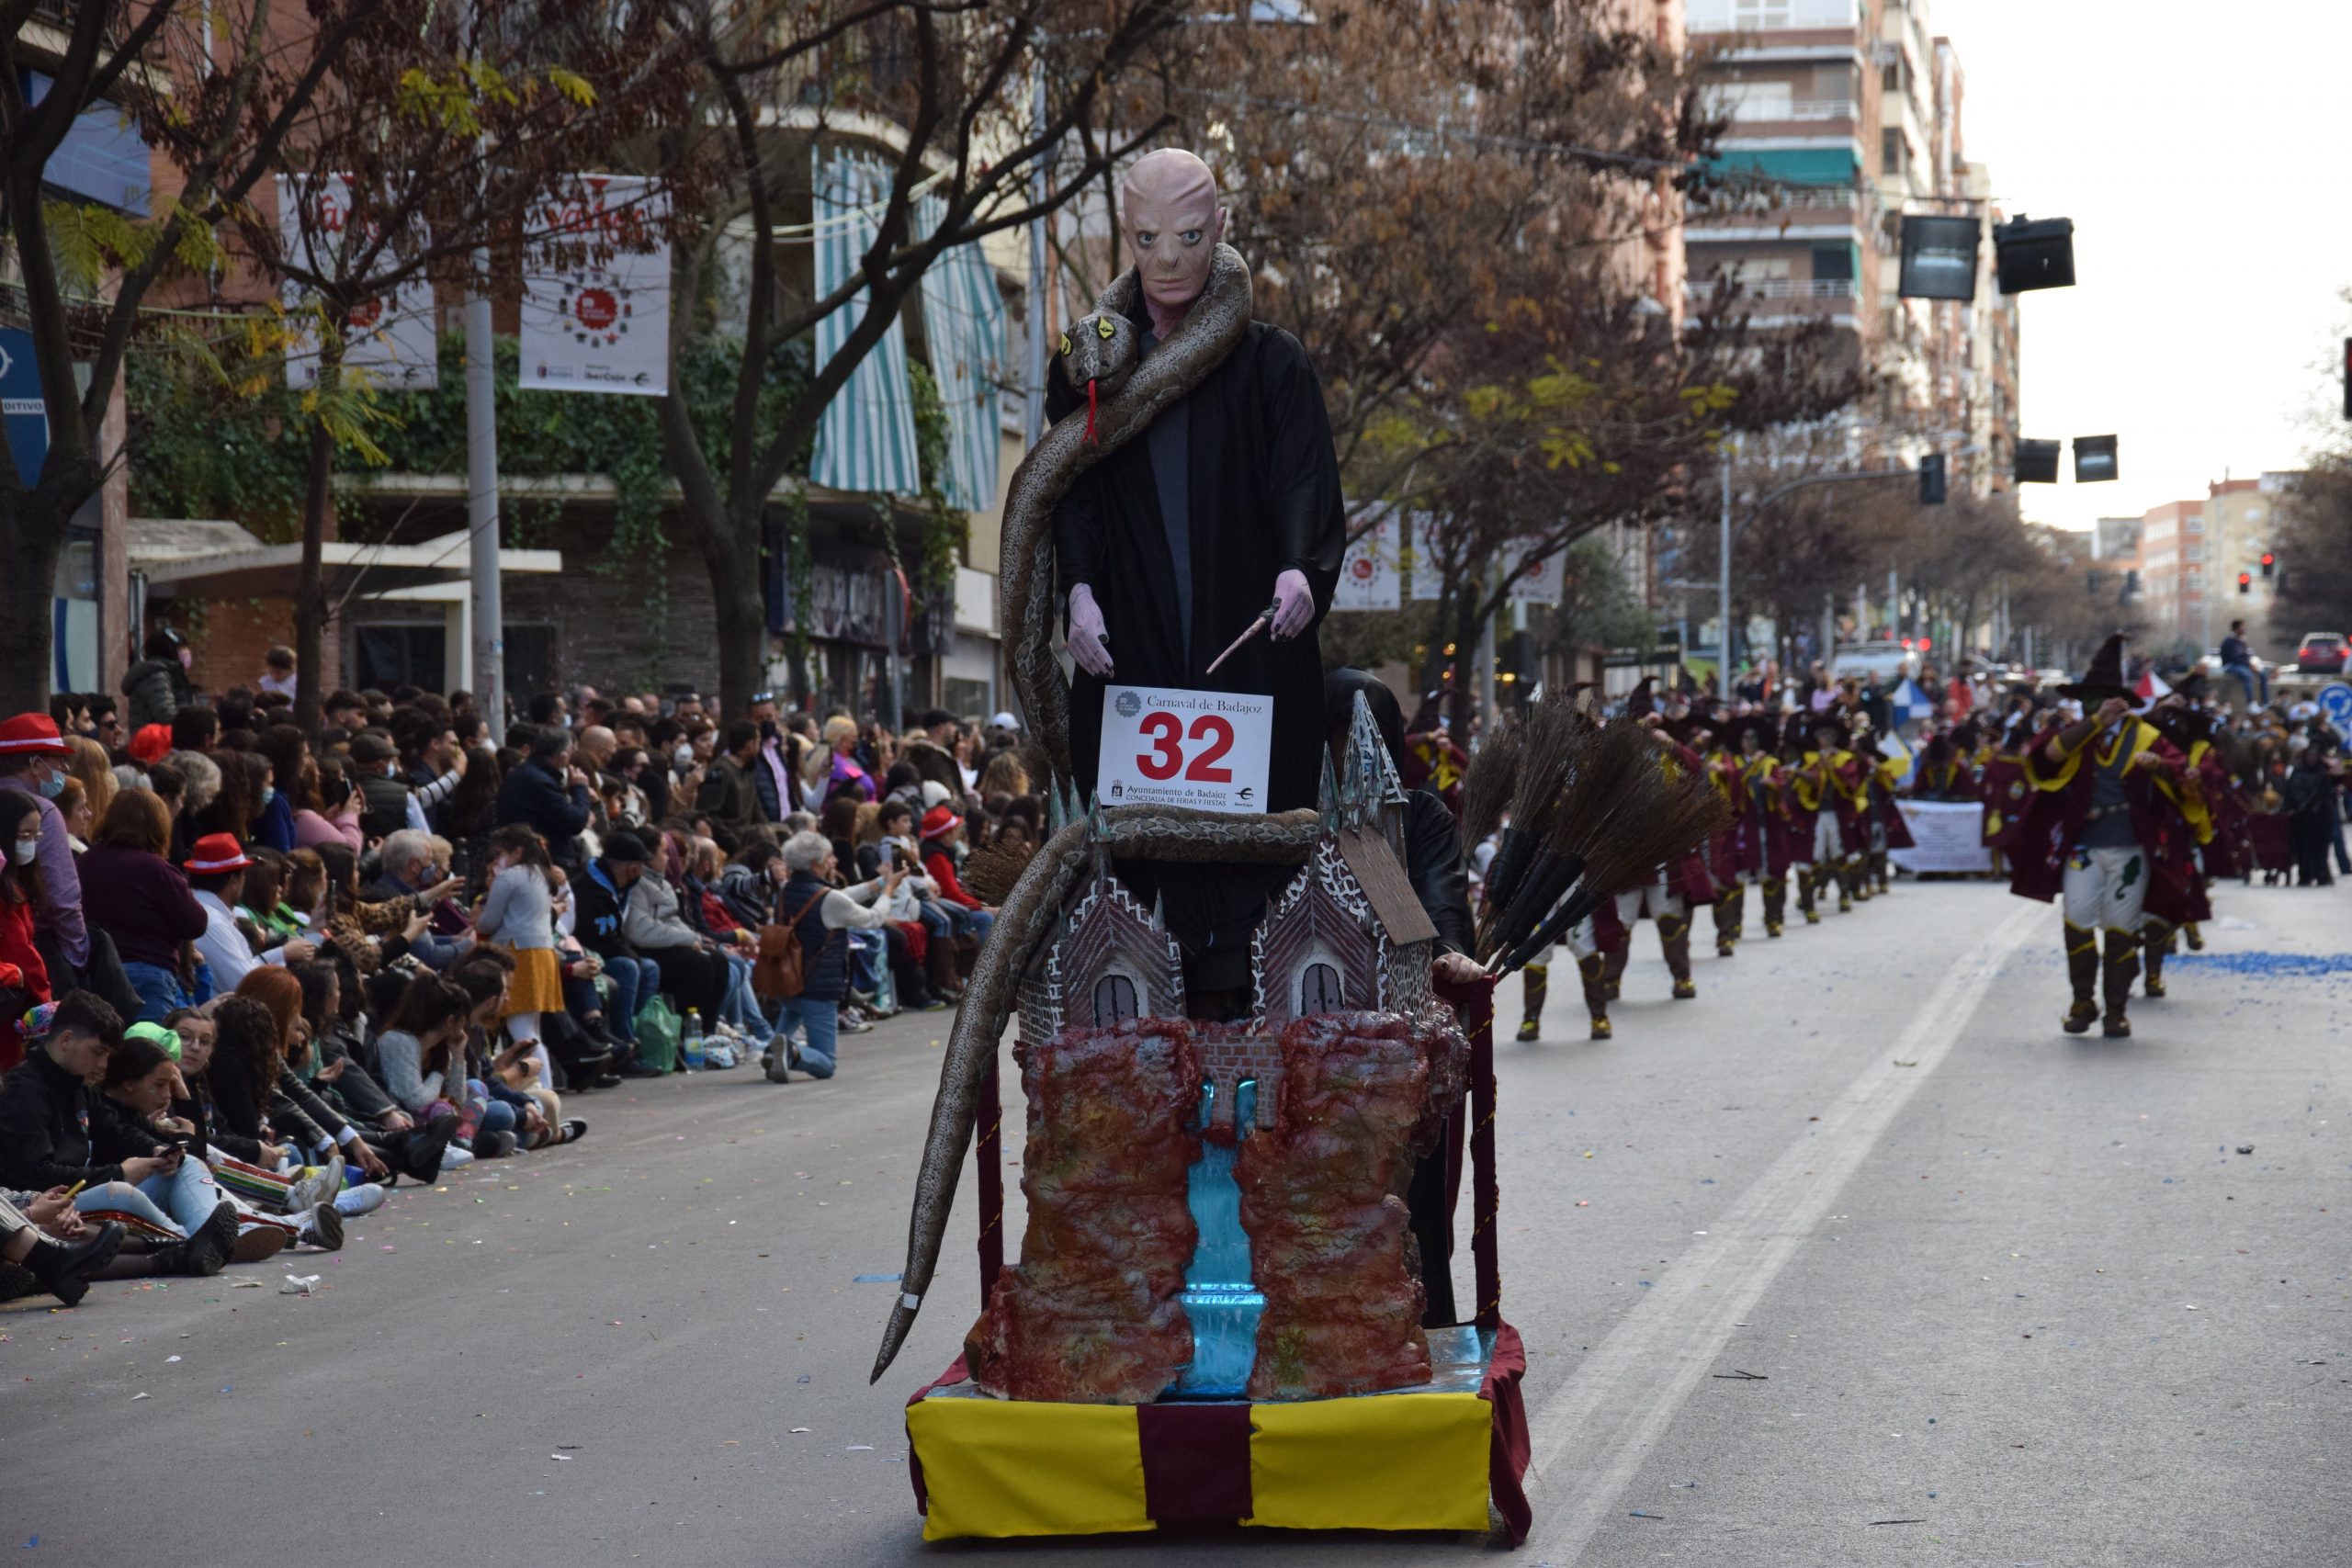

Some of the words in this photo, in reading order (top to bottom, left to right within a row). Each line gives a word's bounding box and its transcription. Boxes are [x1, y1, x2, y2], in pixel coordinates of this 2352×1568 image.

[1147, 695, 1196, 709] Carnaval
[1199, 699, 1214, 710] de
[1217, 700, 1263, 715] Badajoz
[1136, 712, 1234, 783] 32
[1127, 786, 1182, 796] Ayuntamiento
[1197, 789, 1227, 799] Badajoz
